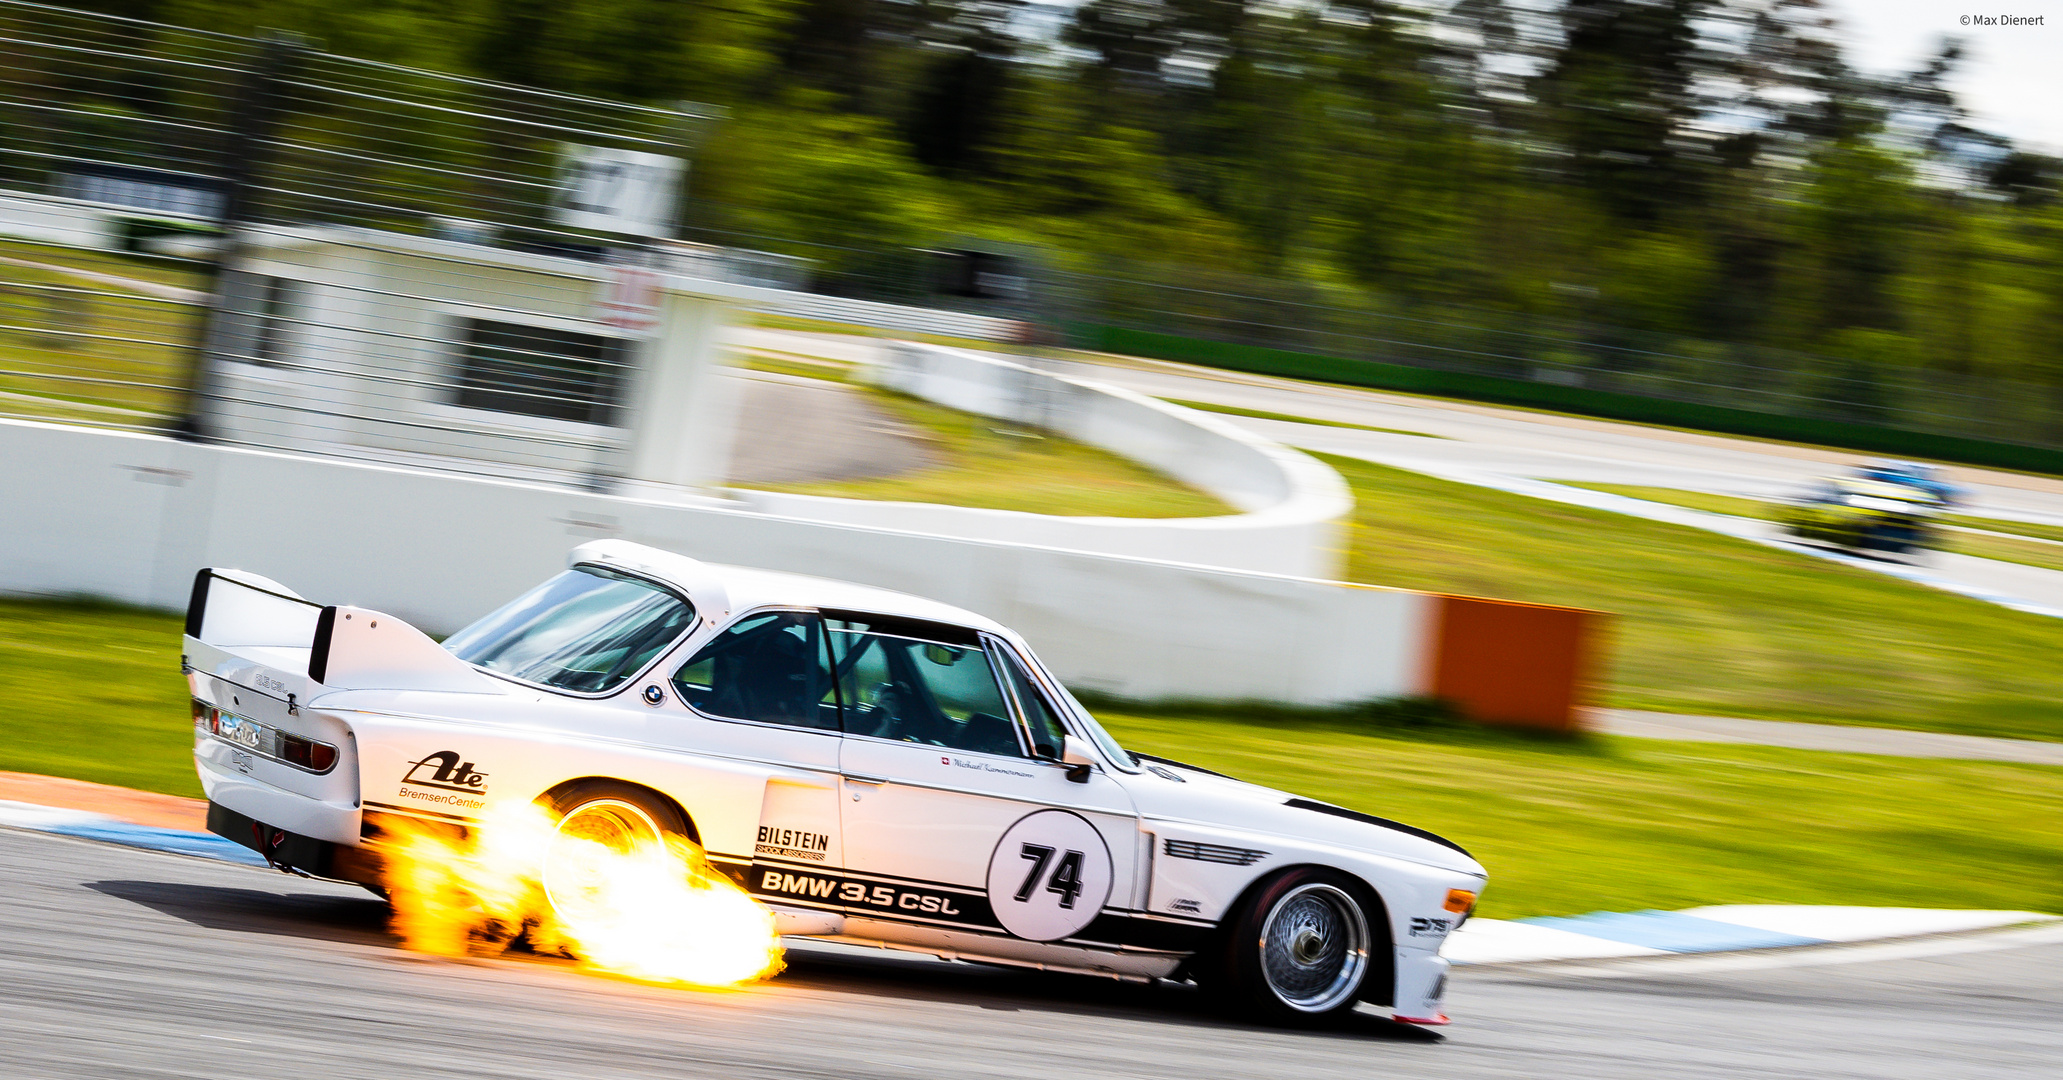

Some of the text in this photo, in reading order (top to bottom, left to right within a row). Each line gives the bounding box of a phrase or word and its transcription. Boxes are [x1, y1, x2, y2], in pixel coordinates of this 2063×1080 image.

[401, 750, 485, 788] Ate
[398, 787, 486, 810] BremsenCenter
[757, 825, 829, 852] BILSTEIN
[761, 870, 960, 916] BMW 3.5 CSL
[1012, 841, 1086, 911] 74
